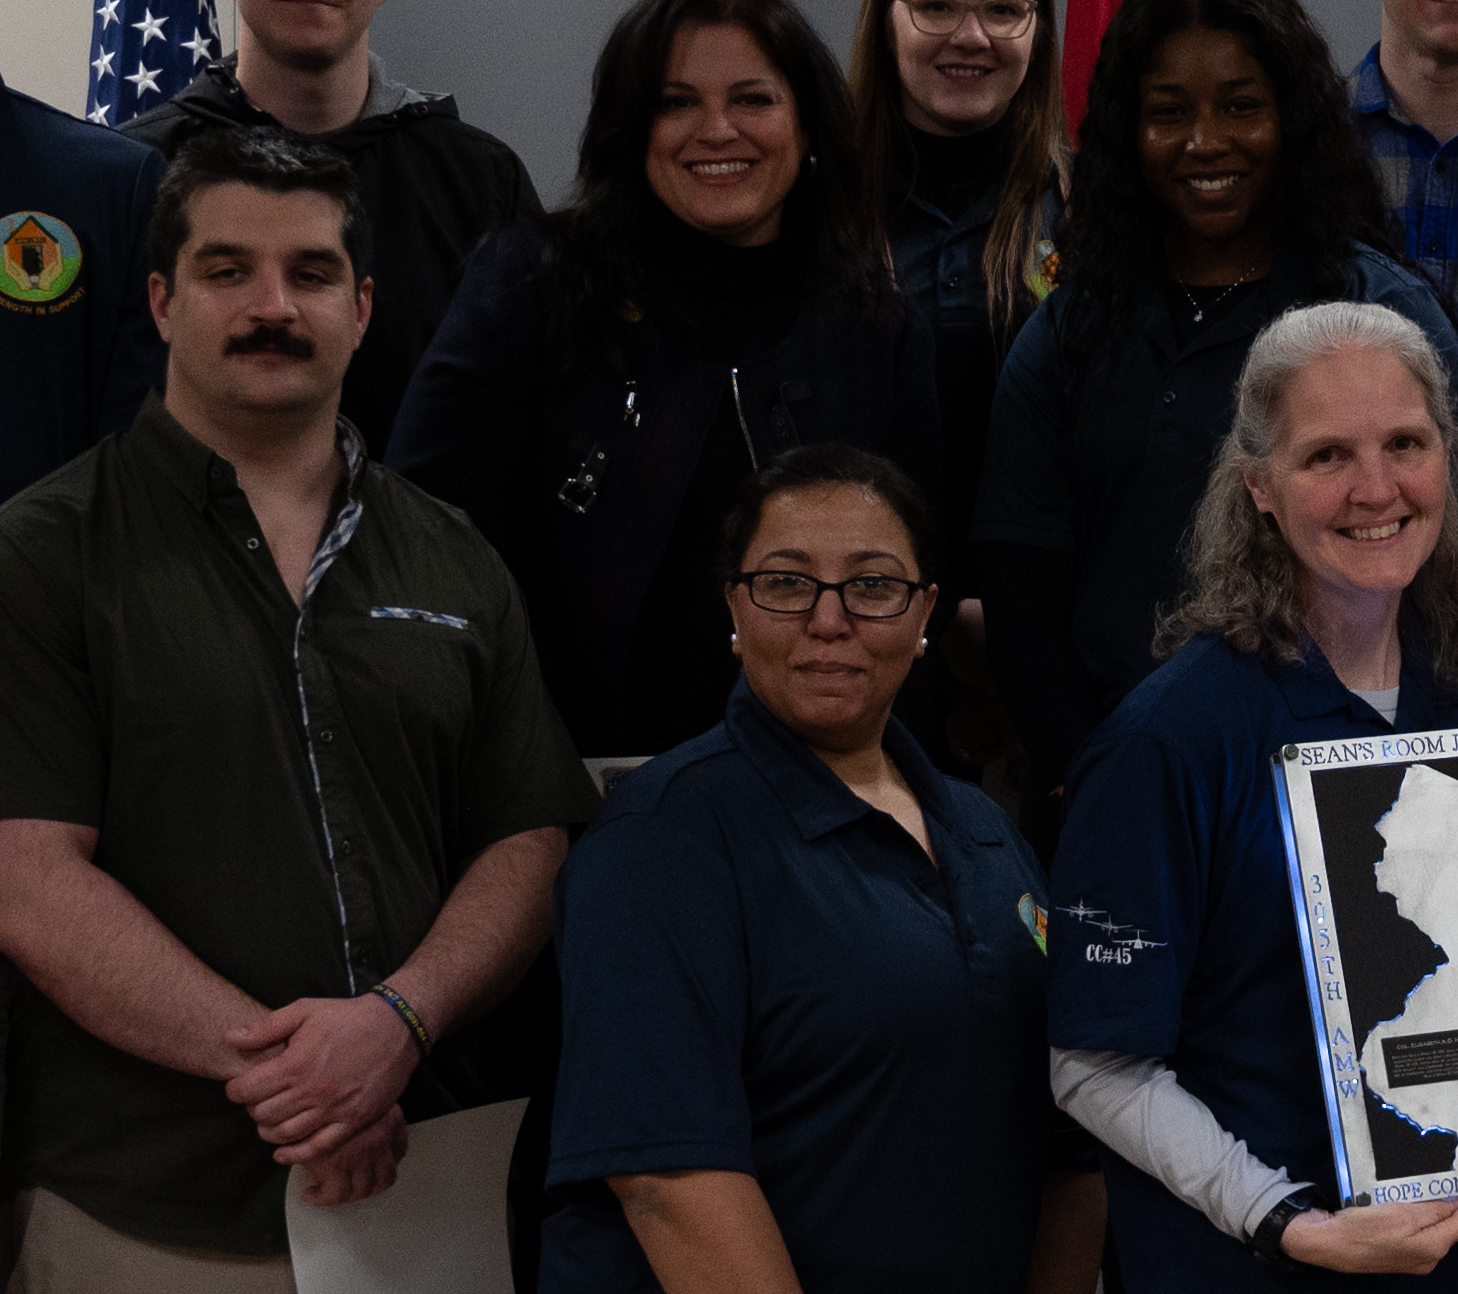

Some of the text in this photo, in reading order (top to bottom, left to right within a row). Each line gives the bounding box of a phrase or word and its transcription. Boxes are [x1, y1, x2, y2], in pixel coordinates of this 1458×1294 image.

[36, 307, 46, 316] IN
[49, 286, 86, 314] SUPPORT
[1300, 741, 1375, 767] SEAN'S
[1380, 735, 1446, 759] ROOM
[1086, 943, 1132, 965] CC#45
[1310, 874, 1359, 1098] 305TH AMW
[1373, 1182, 1423, 1205] HOPE
